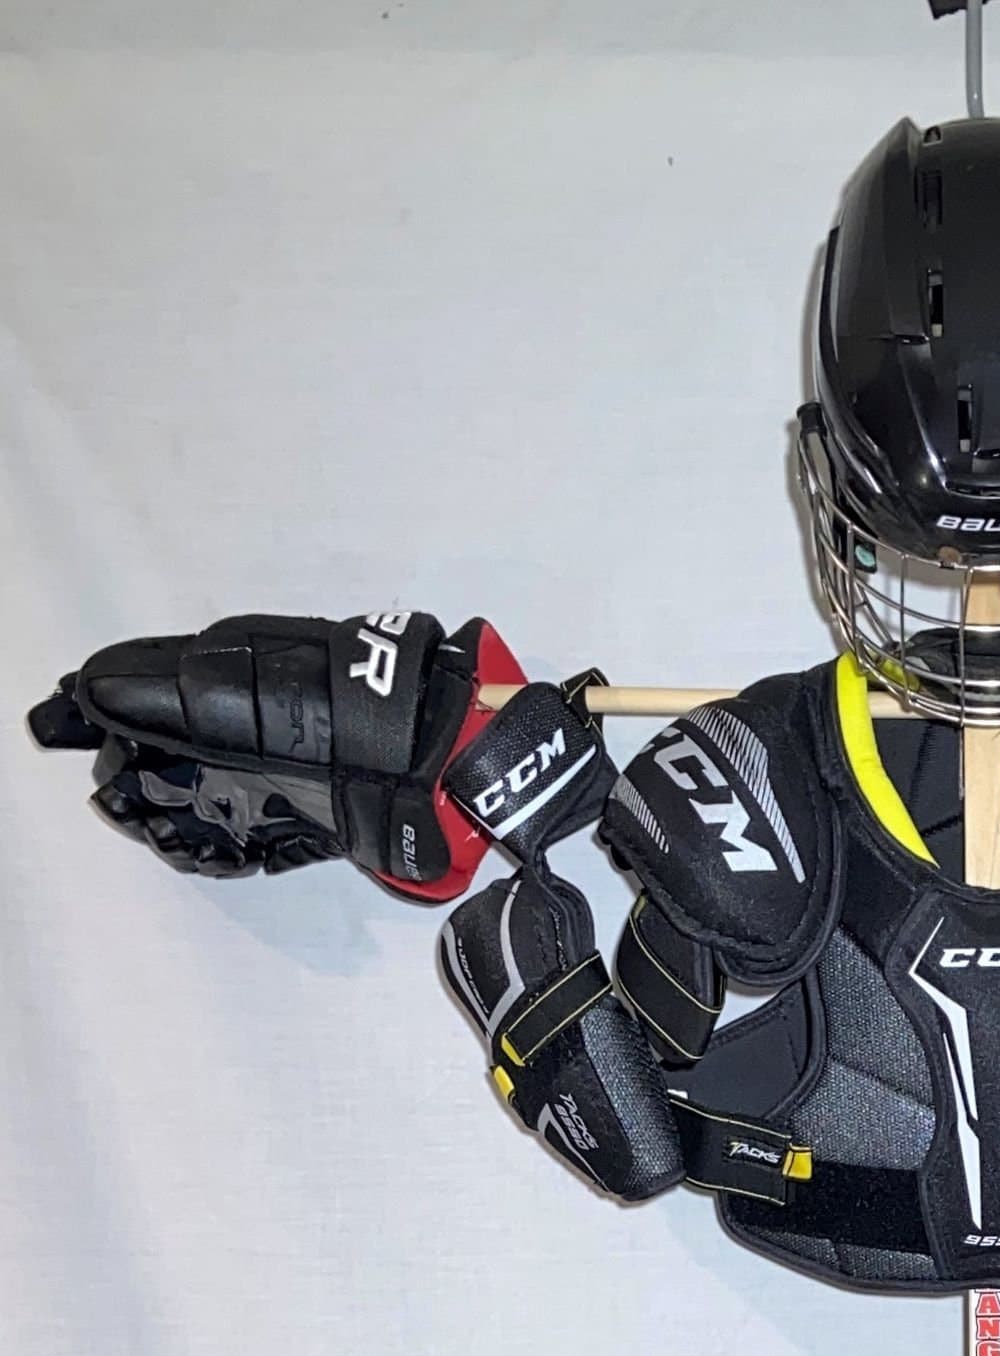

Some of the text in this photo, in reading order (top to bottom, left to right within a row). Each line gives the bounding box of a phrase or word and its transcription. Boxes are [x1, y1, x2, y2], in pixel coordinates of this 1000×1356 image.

[472, 727, 566, 817] CCM
[559, 1093, 600, 1150] TACKS
[729, 1141, 782, 1164] TACKS
